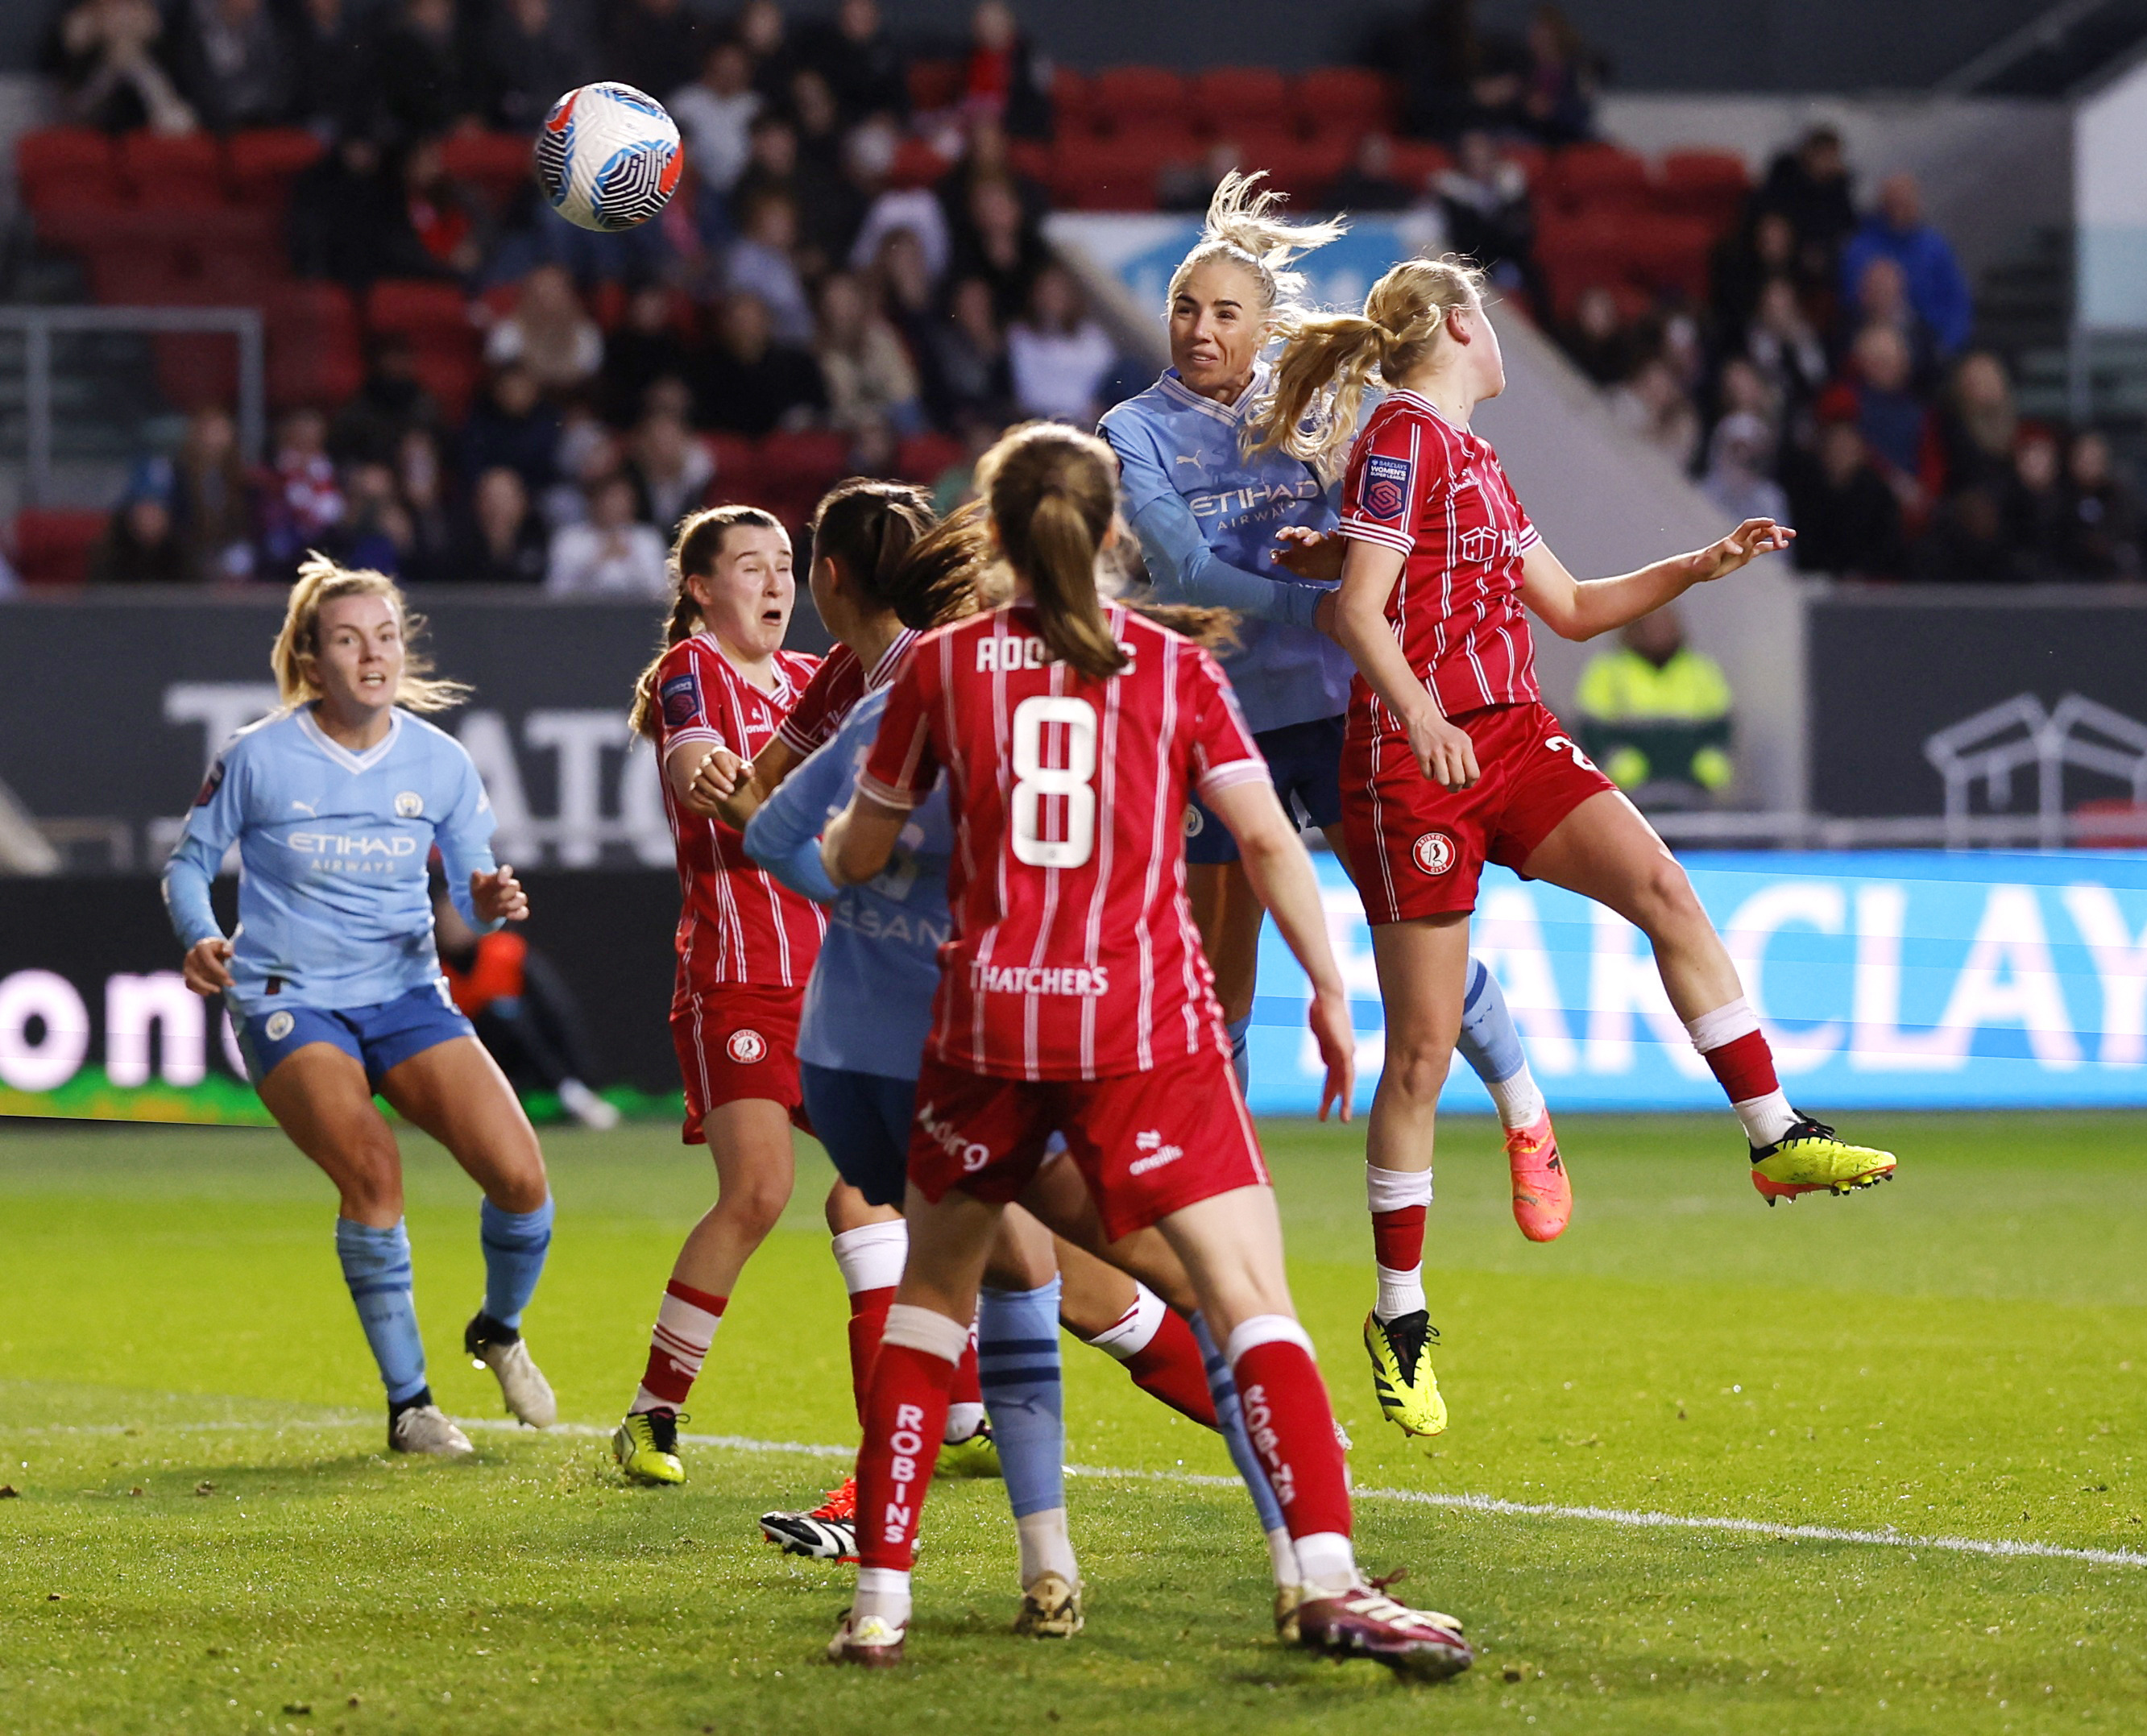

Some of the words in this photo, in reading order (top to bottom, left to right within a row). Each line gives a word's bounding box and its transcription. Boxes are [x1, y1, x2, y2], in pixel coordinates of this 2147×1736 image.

[1370, 466, 1407, 478] WOMEN'S
[1378, 461, 1407, 470] BARCLAYS
[1386, 474, 1406, 482] LEAGUE
[1189, 479, 1320, 518] ETIHAD
[1012, 695, 1097, 868] 8
[287, 831, 417, 857] ETIHAD
[1417, 835, 1444, 847] BRISTOL
[310, 859, 395, 873] AIRWAYS
[1430, 863, 1448, 873] CITY
[970, 960, 1109, 996] THATCHERS
[0, 968, 251, 1092] on
[884, 1402, 925, 1544] ROBINS
